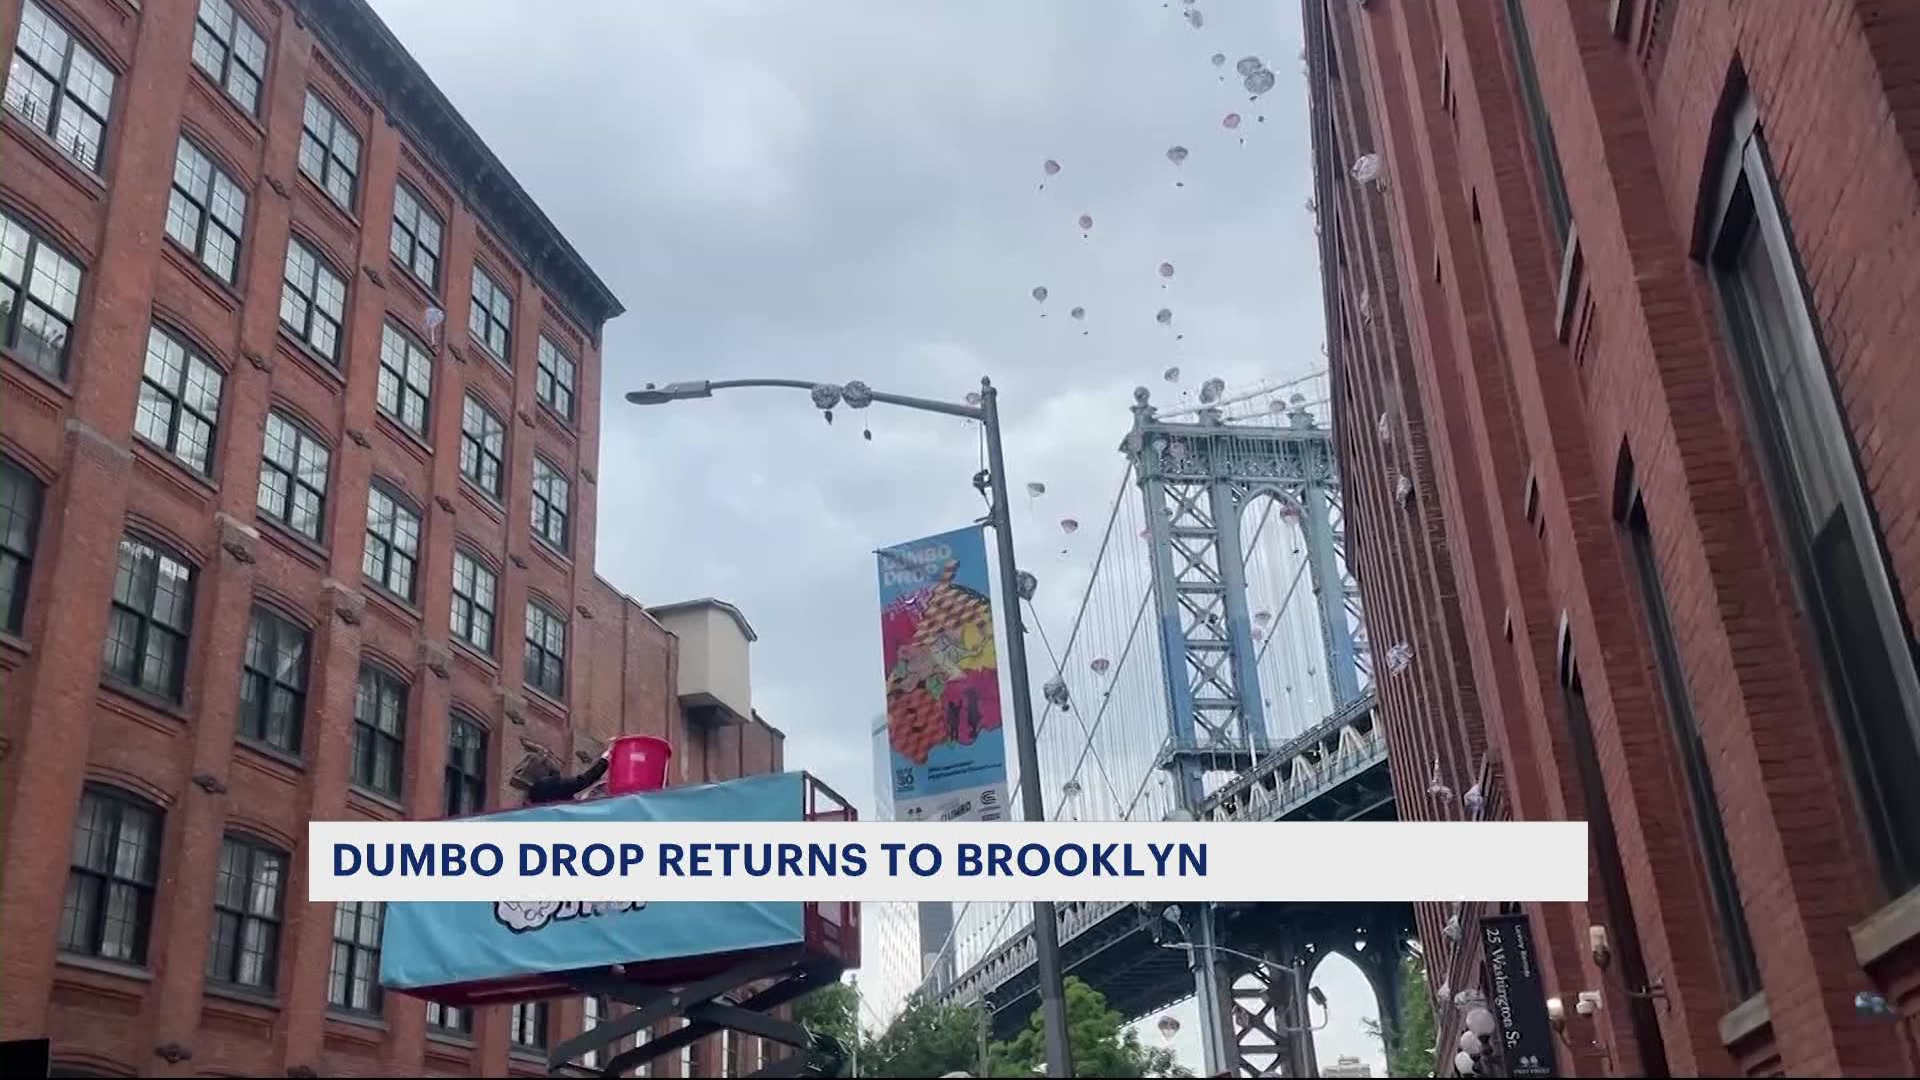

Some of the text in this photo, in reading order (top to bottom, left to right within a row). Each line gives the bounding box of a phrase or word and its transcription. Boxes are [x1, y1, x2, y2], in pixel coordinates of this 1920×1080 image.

[1486, 927, 1520, 1049] 25 Washington St.
